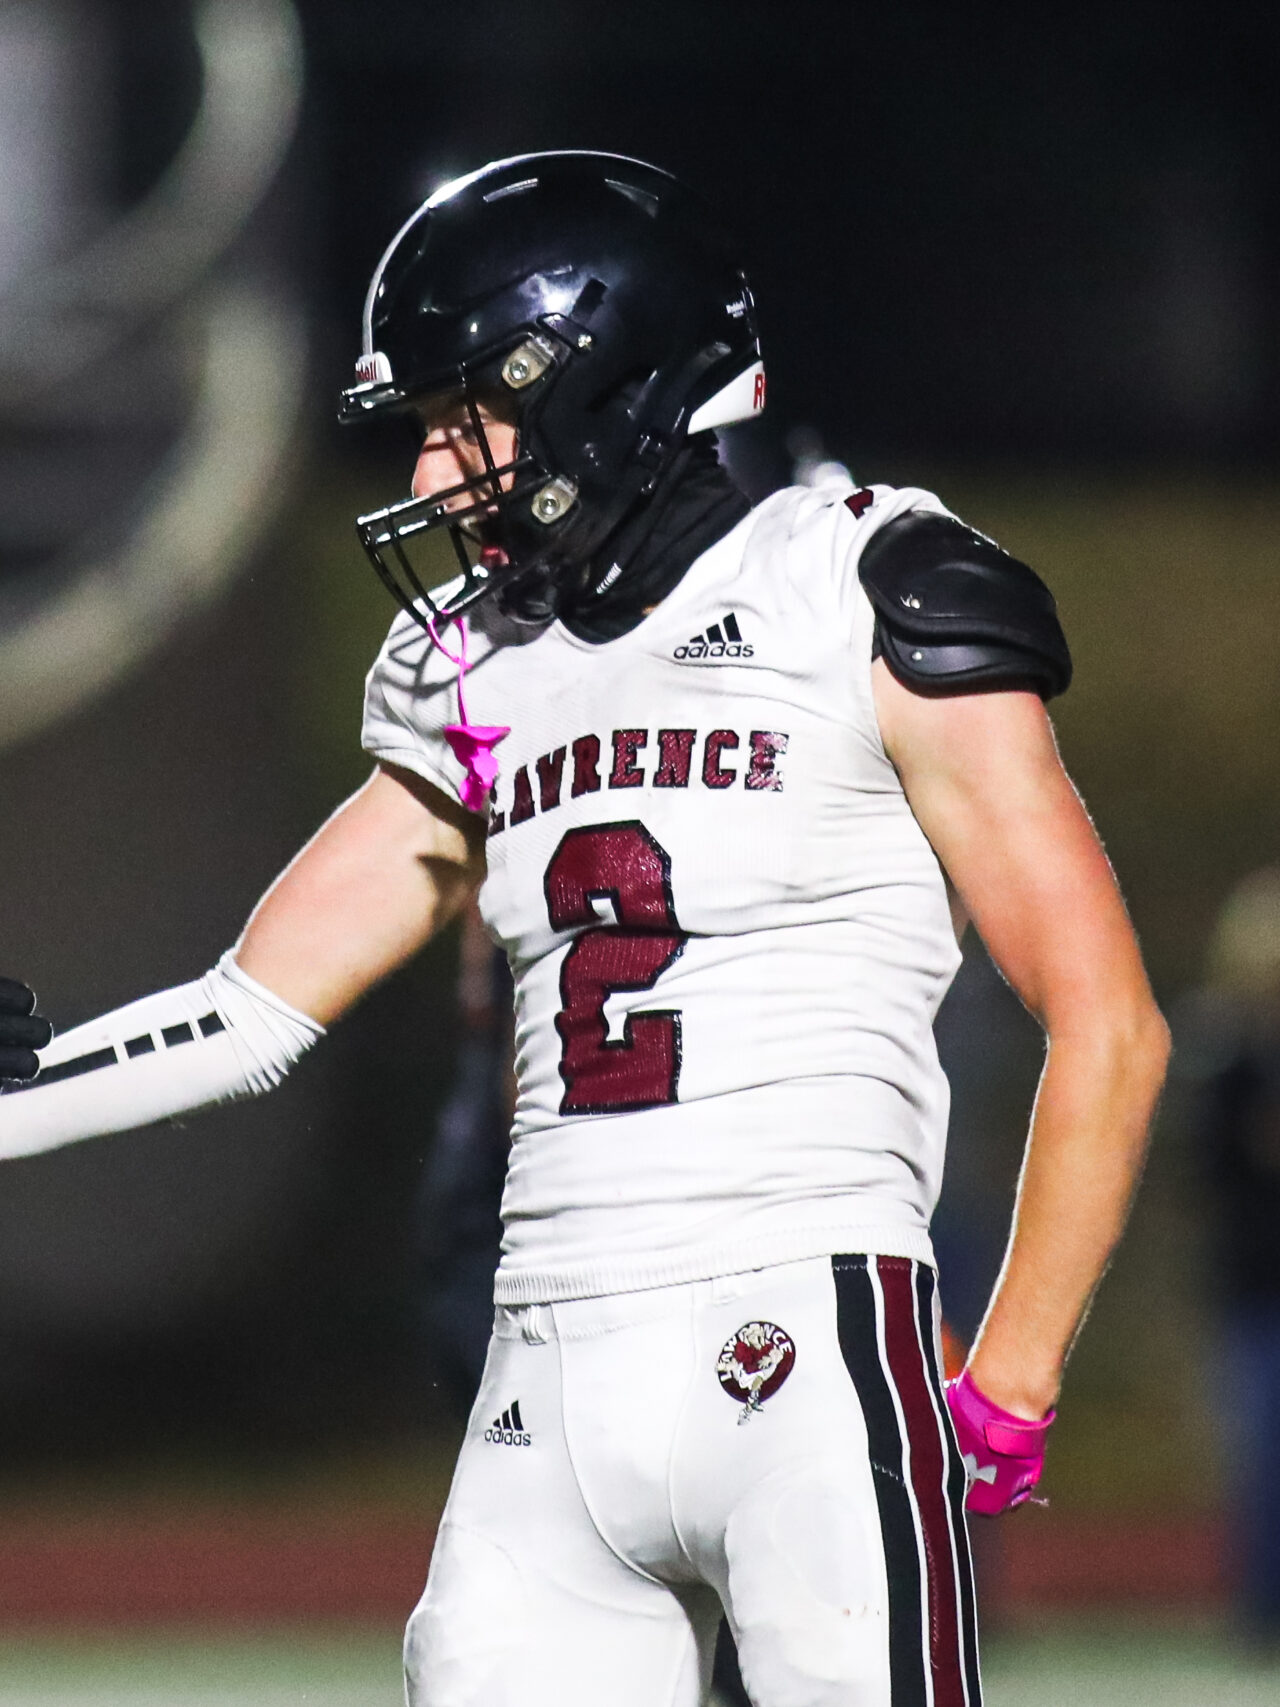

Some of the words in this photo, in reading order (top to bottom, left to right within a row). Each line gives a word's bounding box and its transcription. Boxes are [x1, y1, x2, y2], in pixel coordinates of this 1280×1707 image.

[673, 641, 755, 660] adidas
[543, 819, 689, 1117] 2
[719, 1322, 793, 1383] LAWRNCE
[484, 1425, 532, 1446] adidas
